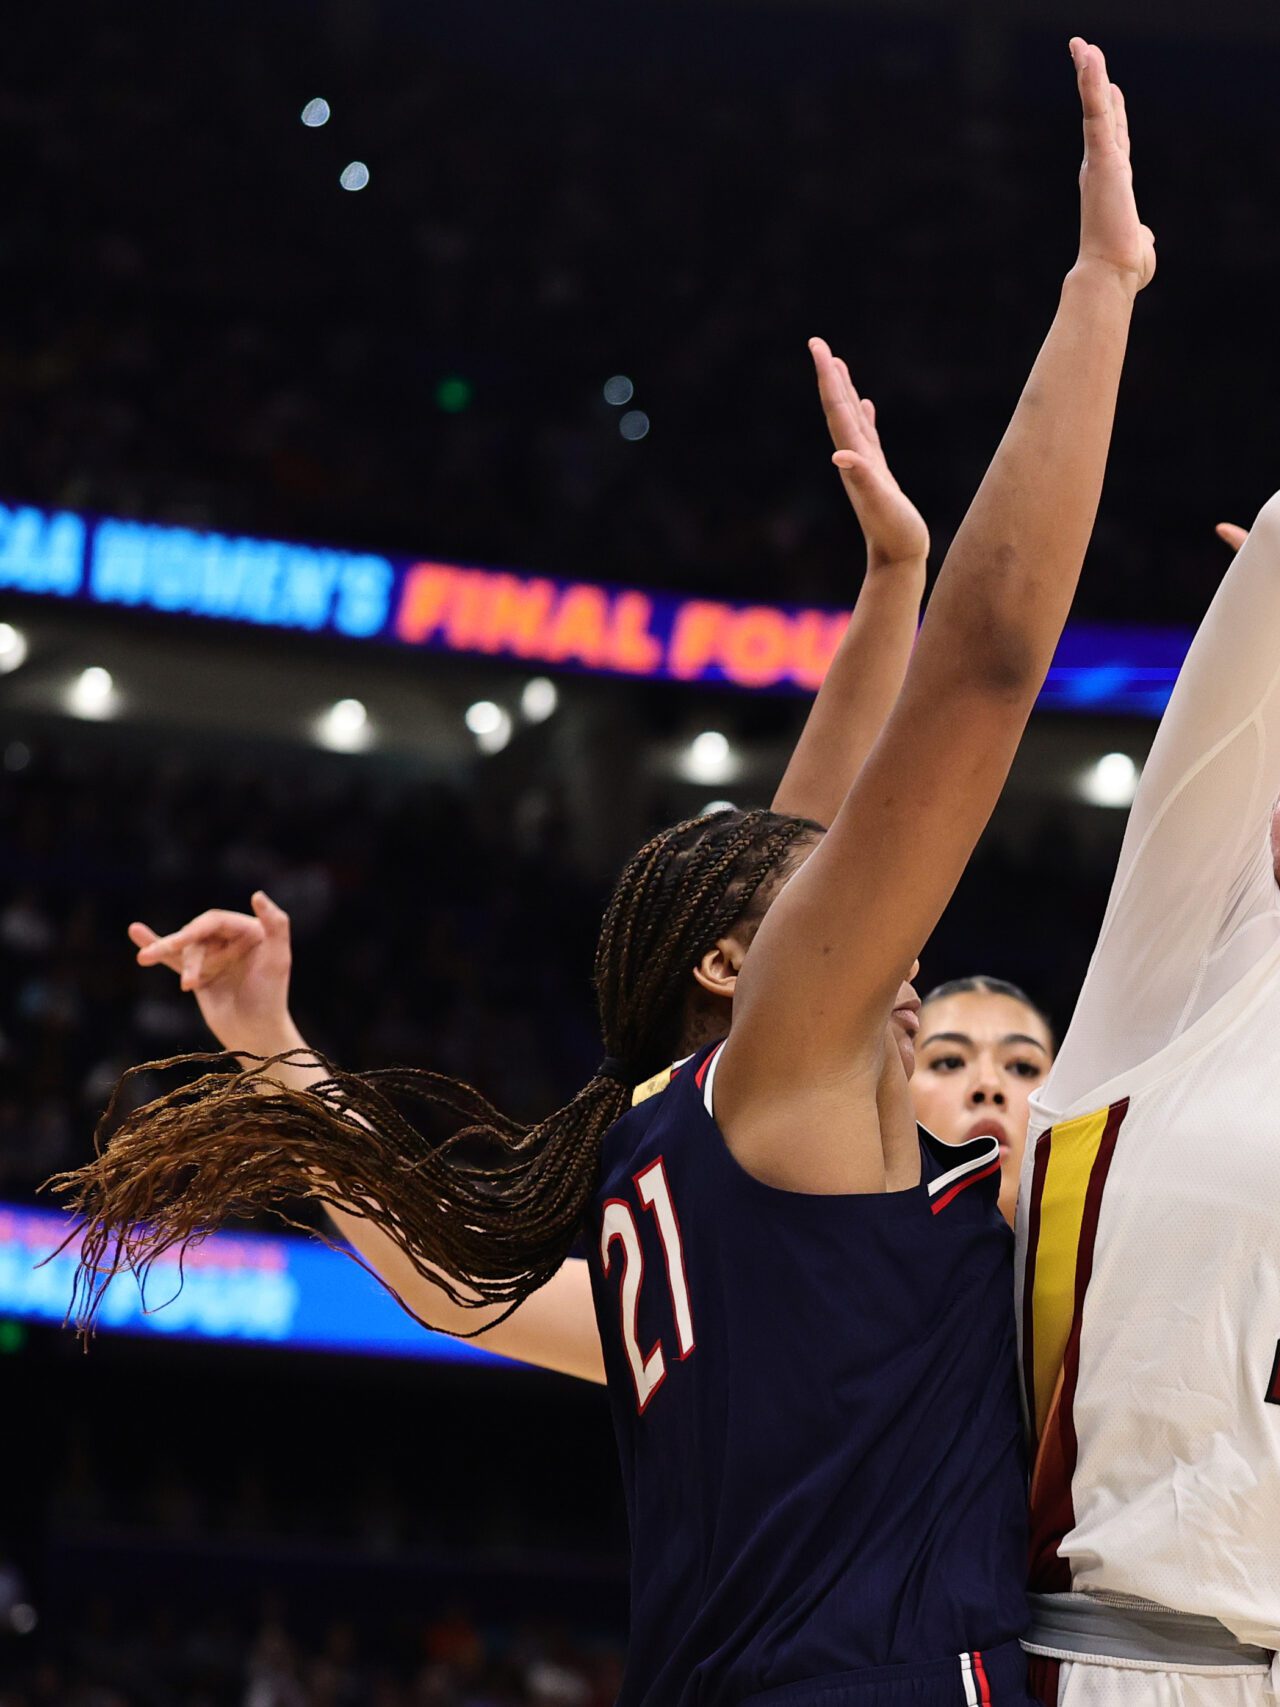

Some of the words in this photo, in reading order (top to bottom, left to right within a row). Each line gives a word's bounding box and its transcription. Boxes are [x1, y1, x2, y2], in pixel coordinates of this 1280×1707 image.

[399, 561, 663, 676] FINAL
[667, 598, 855, 692] FOU
[599, 1154, 697, 1417] 21
